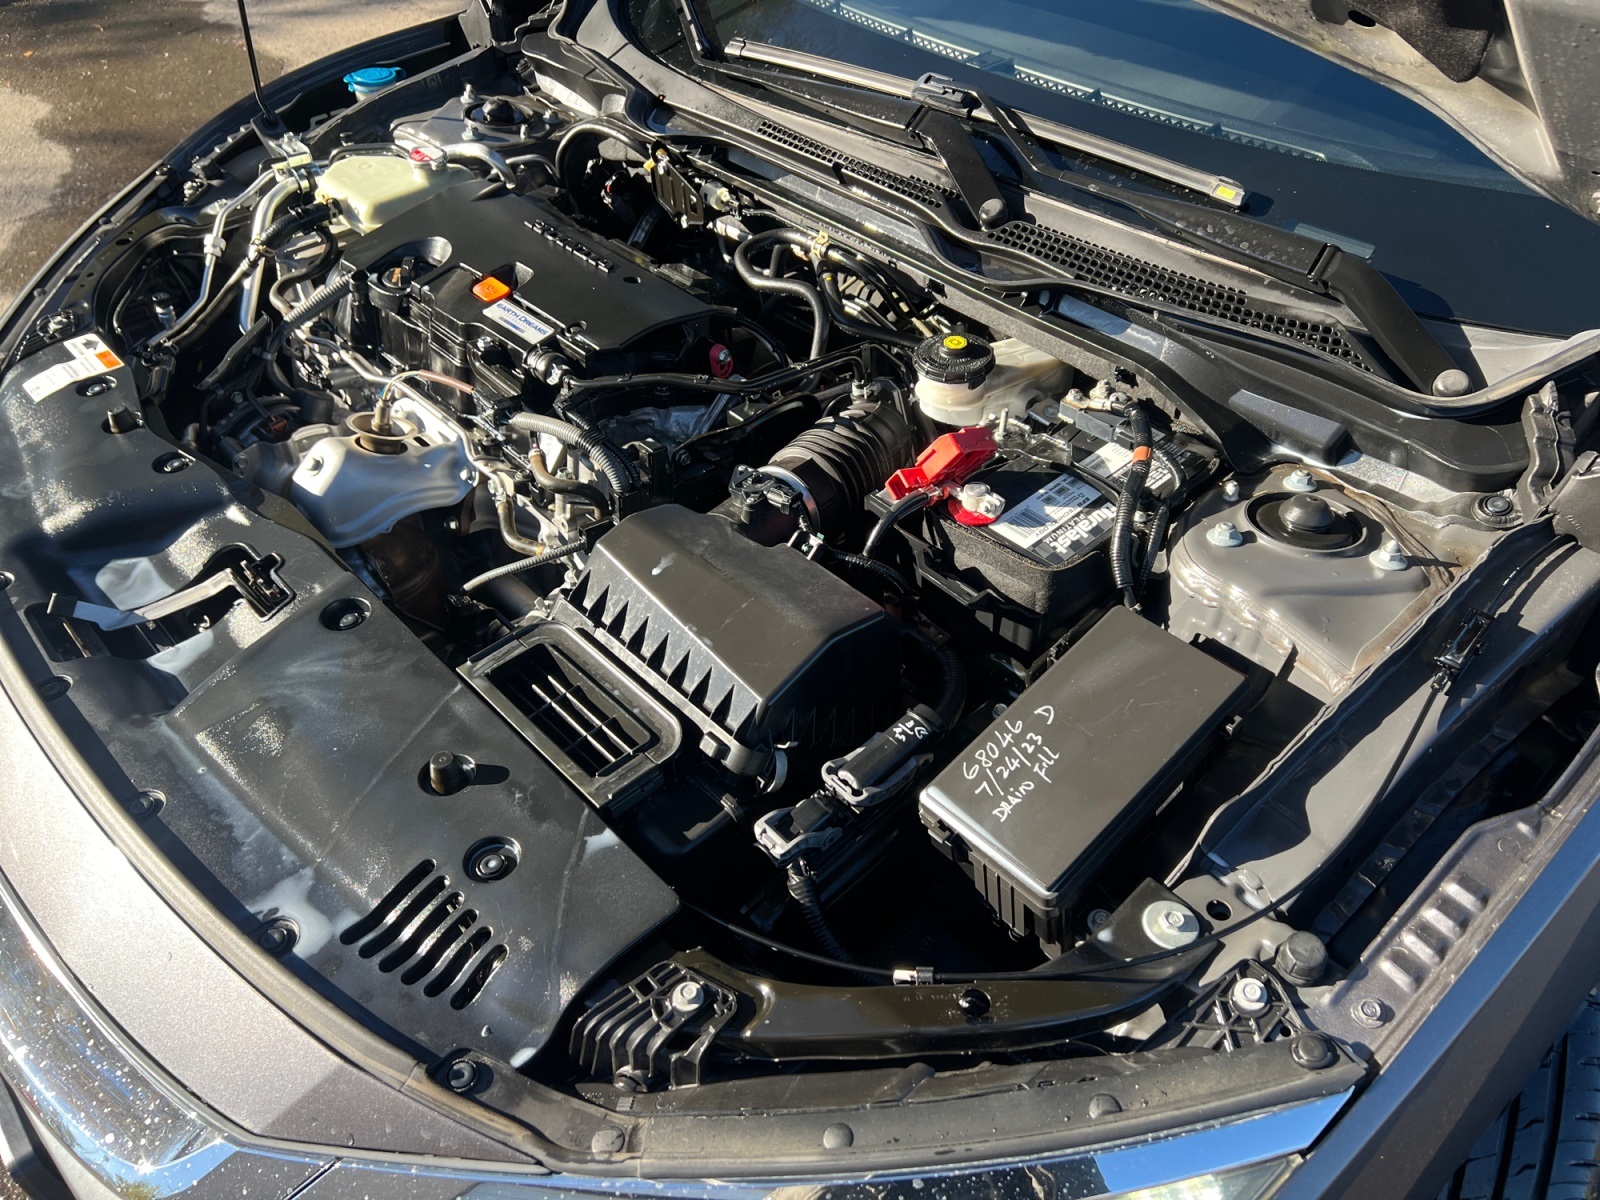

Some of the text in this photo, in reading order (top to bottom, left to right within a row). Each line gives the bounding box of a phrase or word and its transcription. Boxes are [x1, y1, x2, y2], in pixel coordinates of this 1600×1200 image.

[496, 302, 520, 318] EARTH
[518, 315, 548, 335] DREAMS
[1077, 496, 1091, 507] EFB
[1035, 507, 1075, 538] TECHNOLOGY
[1044, 512, 1086, 543] PLATINUM
[1049, 501, 1118, 554] Duralast
[963, 720, 1023, 780] 68046
[974, 733, 1042, 796] 7/24/23
